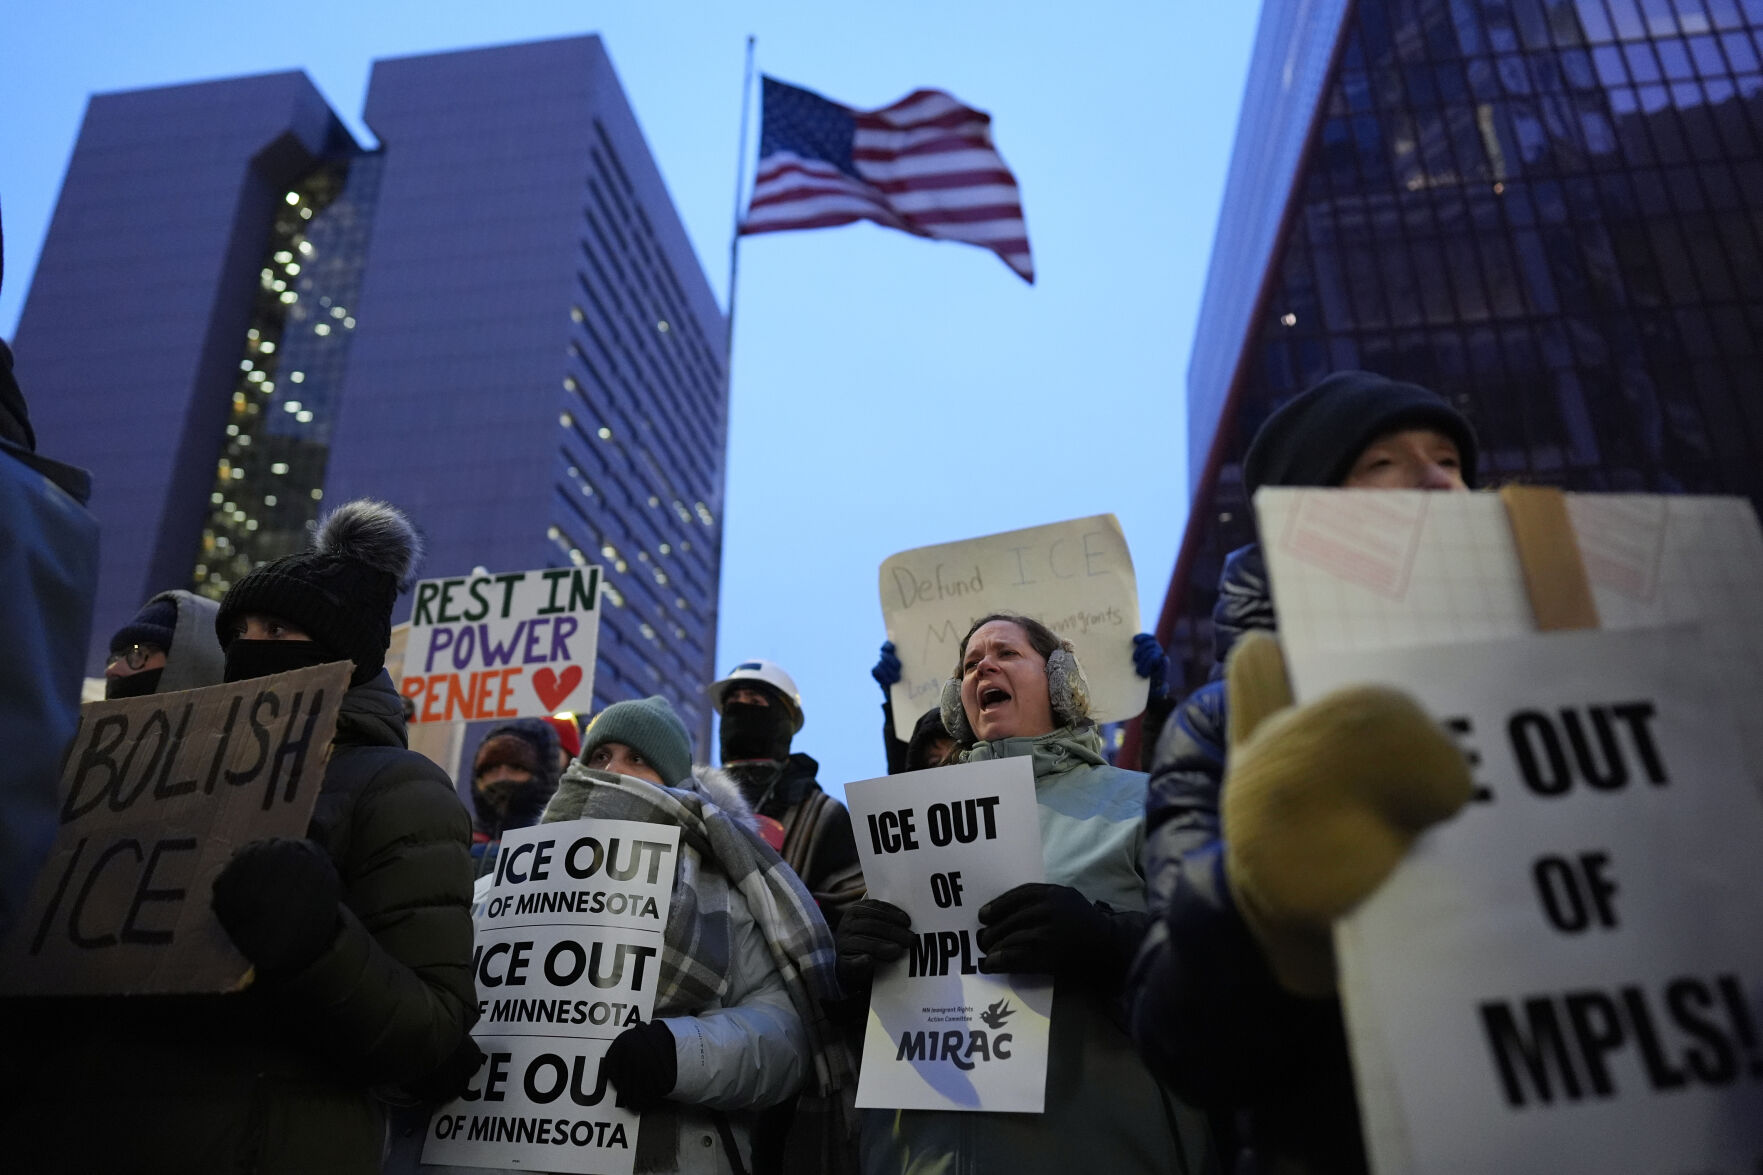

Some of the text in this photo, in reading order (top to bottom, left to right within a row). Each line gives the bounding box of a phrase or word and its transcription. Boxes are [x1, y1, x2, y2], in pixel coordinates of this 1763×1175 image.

[413, 568, 599, 627] REST IN
[891, 531, 1112, 609] Defund ICE
[424, 616, 579, 673] POWER
[400, 667, 523, 724] RENEE
[1507, 702, 1670, 797] OUT
[867, 796, 1000, 855] ICE OUT
[494, 836, 672, 887] ICE OUT
[930, 871, 964, 909] OF
[30, 837, 198, 956] ICE
[488, 891, 660, 920] OF MINNESOTA
[1532, 852, 1619, 934] OF
[473, 940, 657, 992] ICE OUT
[489, 999, 642, 1028] MINNESOTA
[957, 1006, 974, 1014] Rights
[1480, 974, 1763, 1109] MPLS!
[459, 1053, 625, 1109] CE OU
[435, 1114, 629, 1149] OF MINNESOTA
